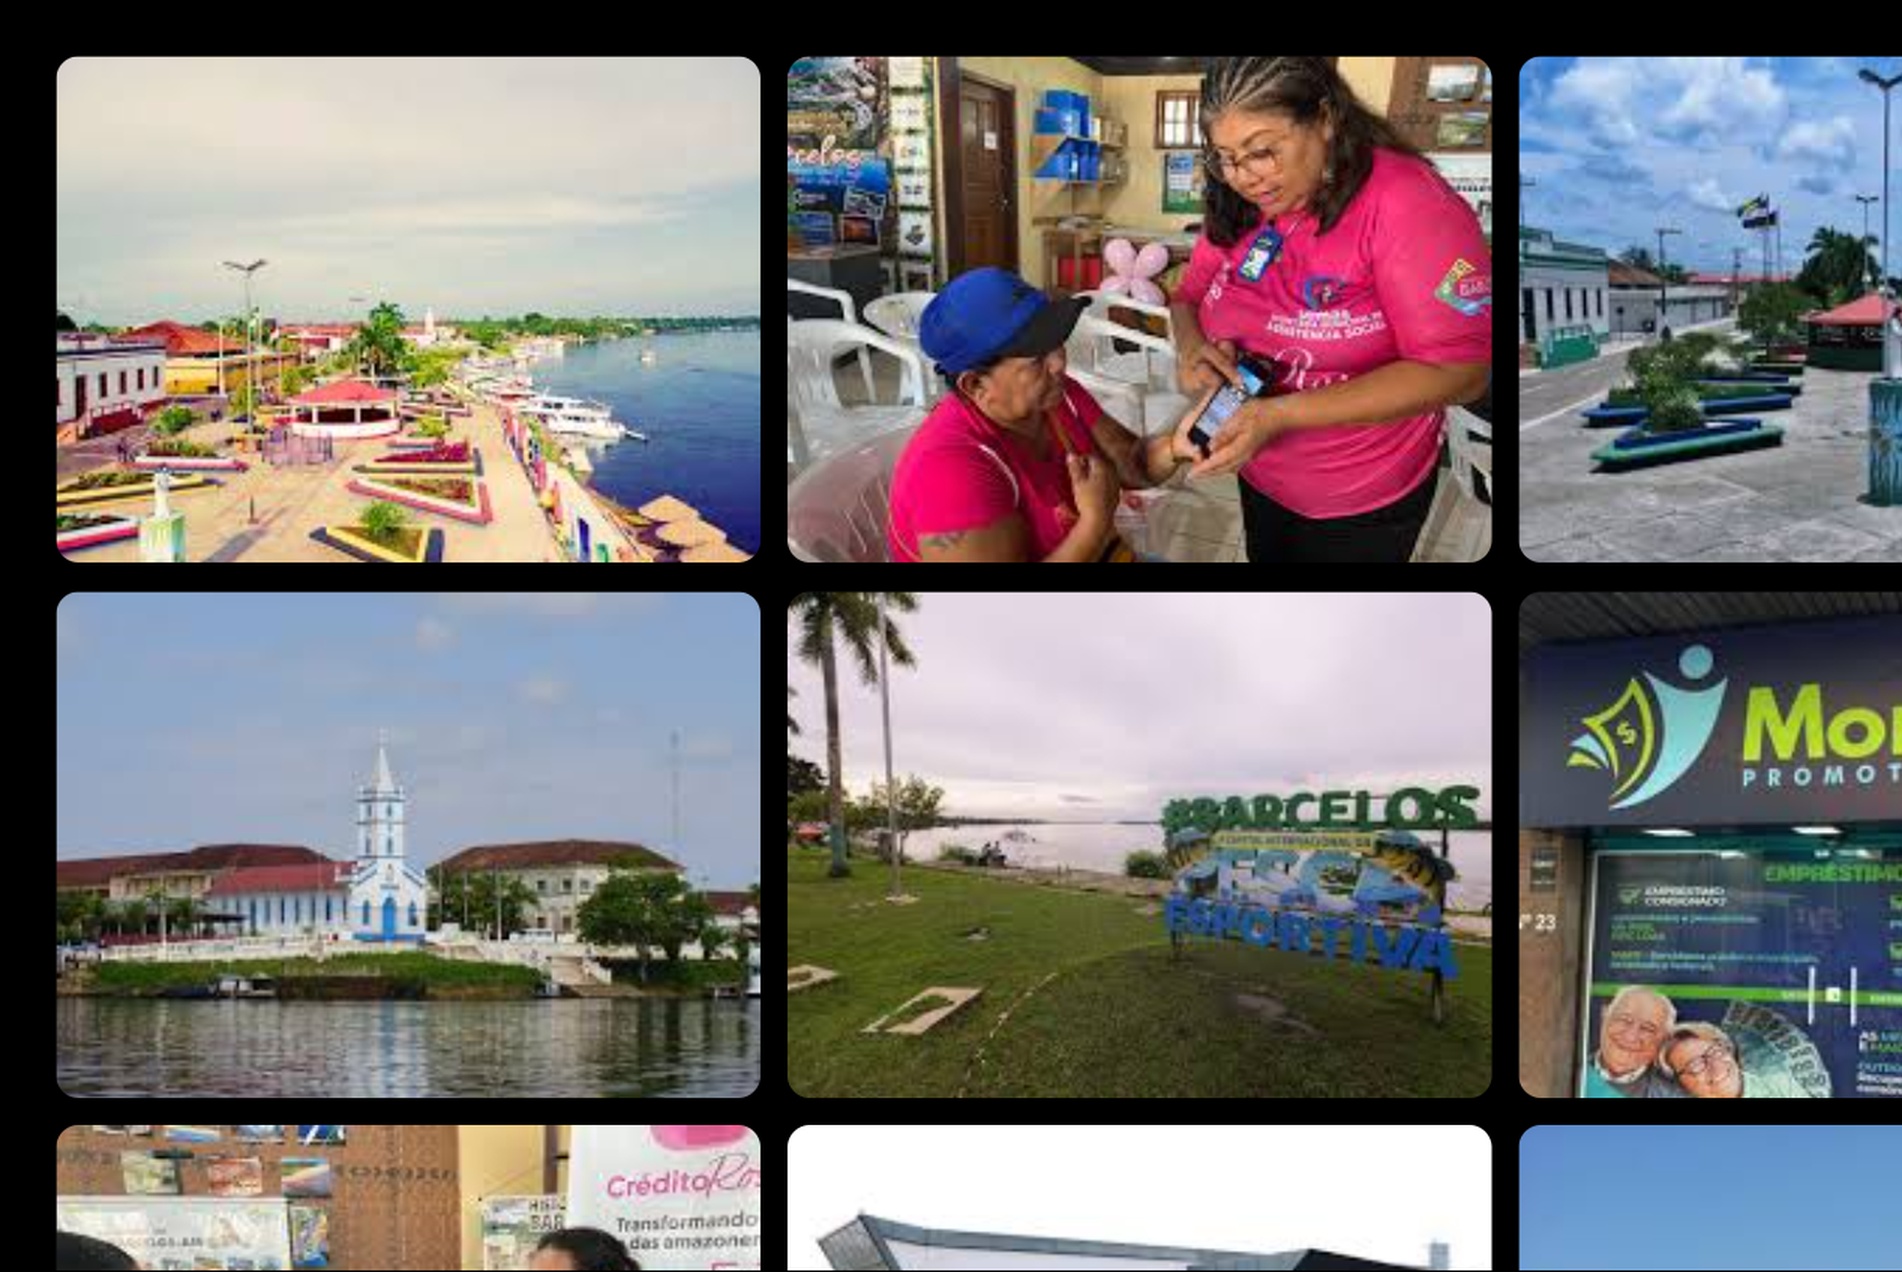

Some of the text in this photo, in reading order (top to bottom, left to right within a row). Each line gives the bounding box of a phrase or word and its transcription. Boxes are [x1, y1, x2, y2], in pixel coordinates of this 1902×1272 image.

[1743, 762, 1902, 787] PROMOT
[1535, 914, 1556, 930] 23
[607, 1169, 709, 1199] Crédito
[616, 1210, 758, 1233] Transformando
[630, 1236, 660, 1250] das
